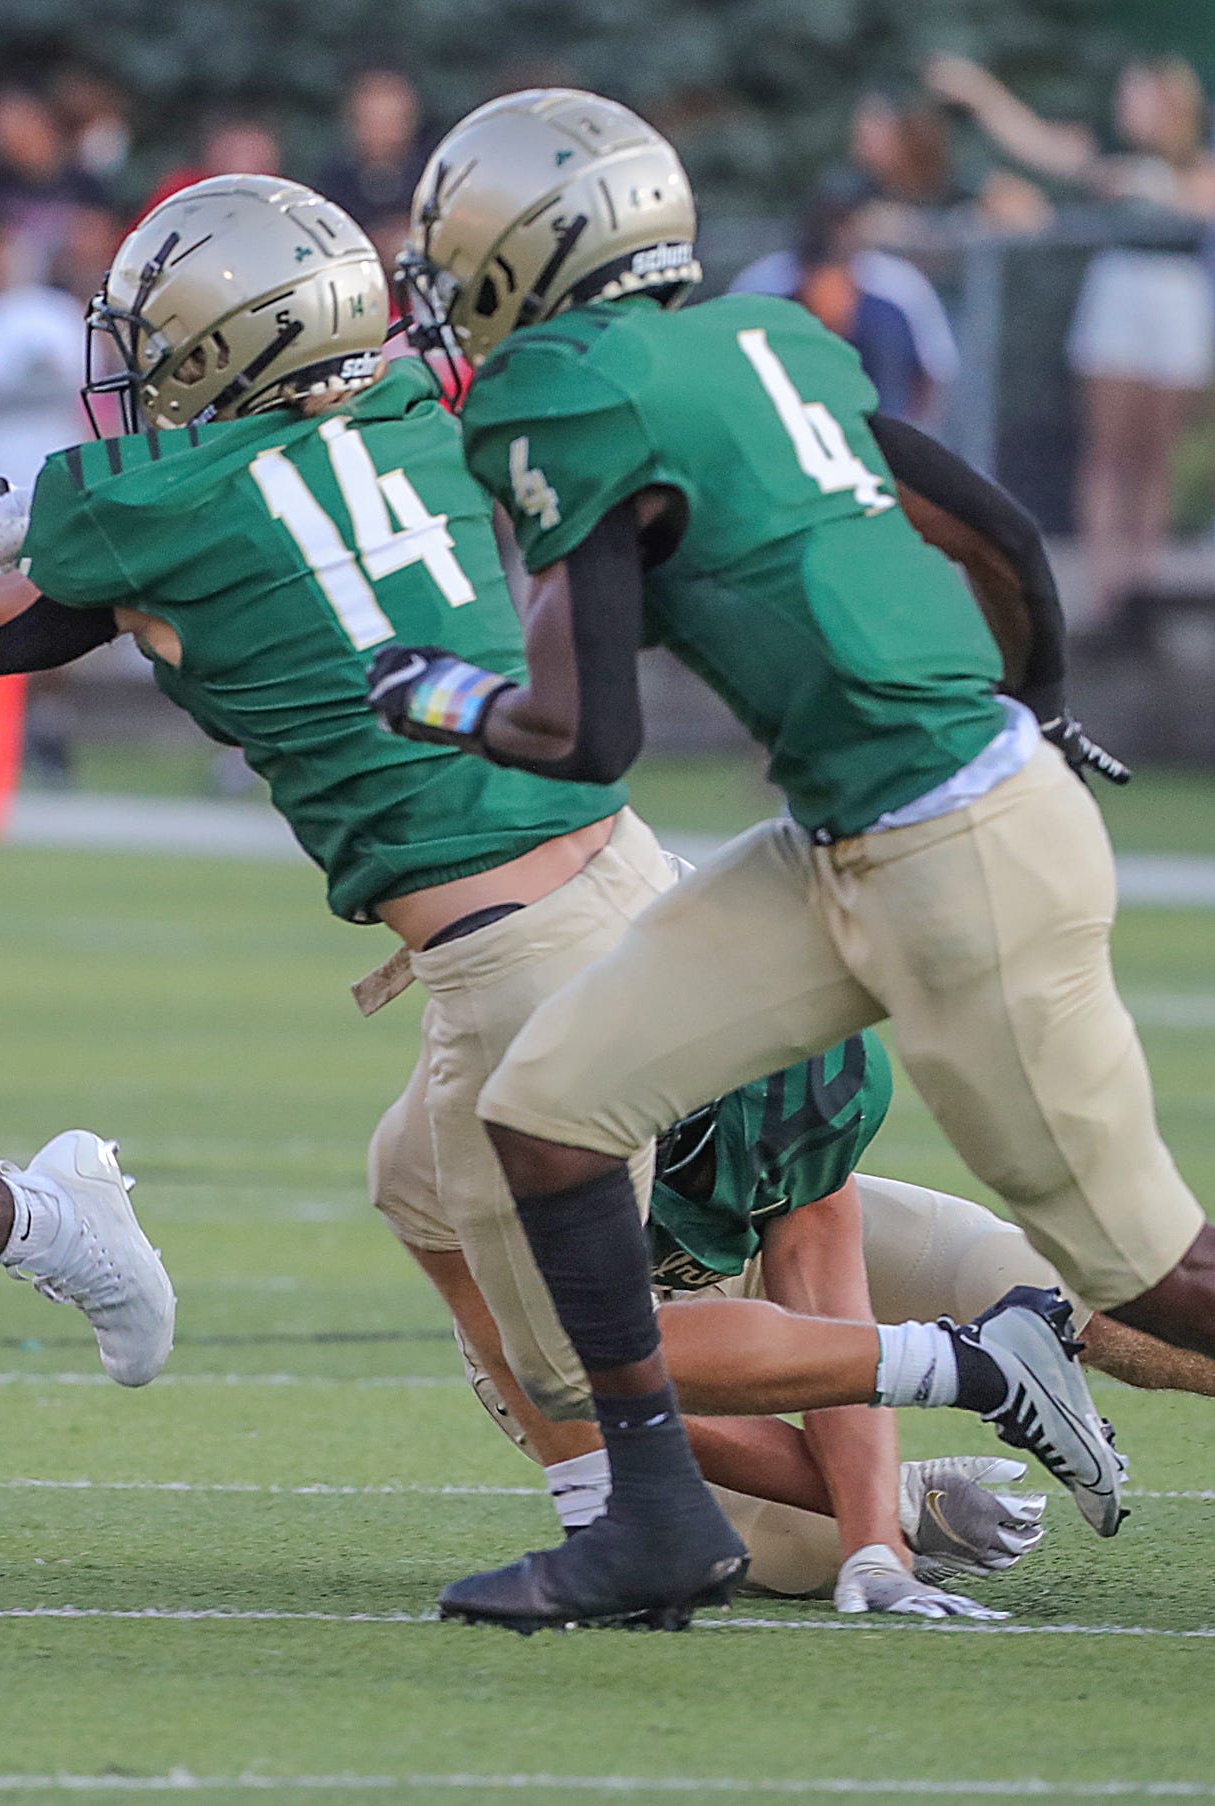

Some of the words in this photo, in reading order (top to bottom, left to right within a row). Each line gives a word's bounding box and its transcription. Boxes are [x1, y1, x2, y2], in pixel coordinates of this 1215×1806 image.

[509, 436, 562, 530] 4
[737, 328, 897, 518] 4
[248, 414, 478, 652] 14
